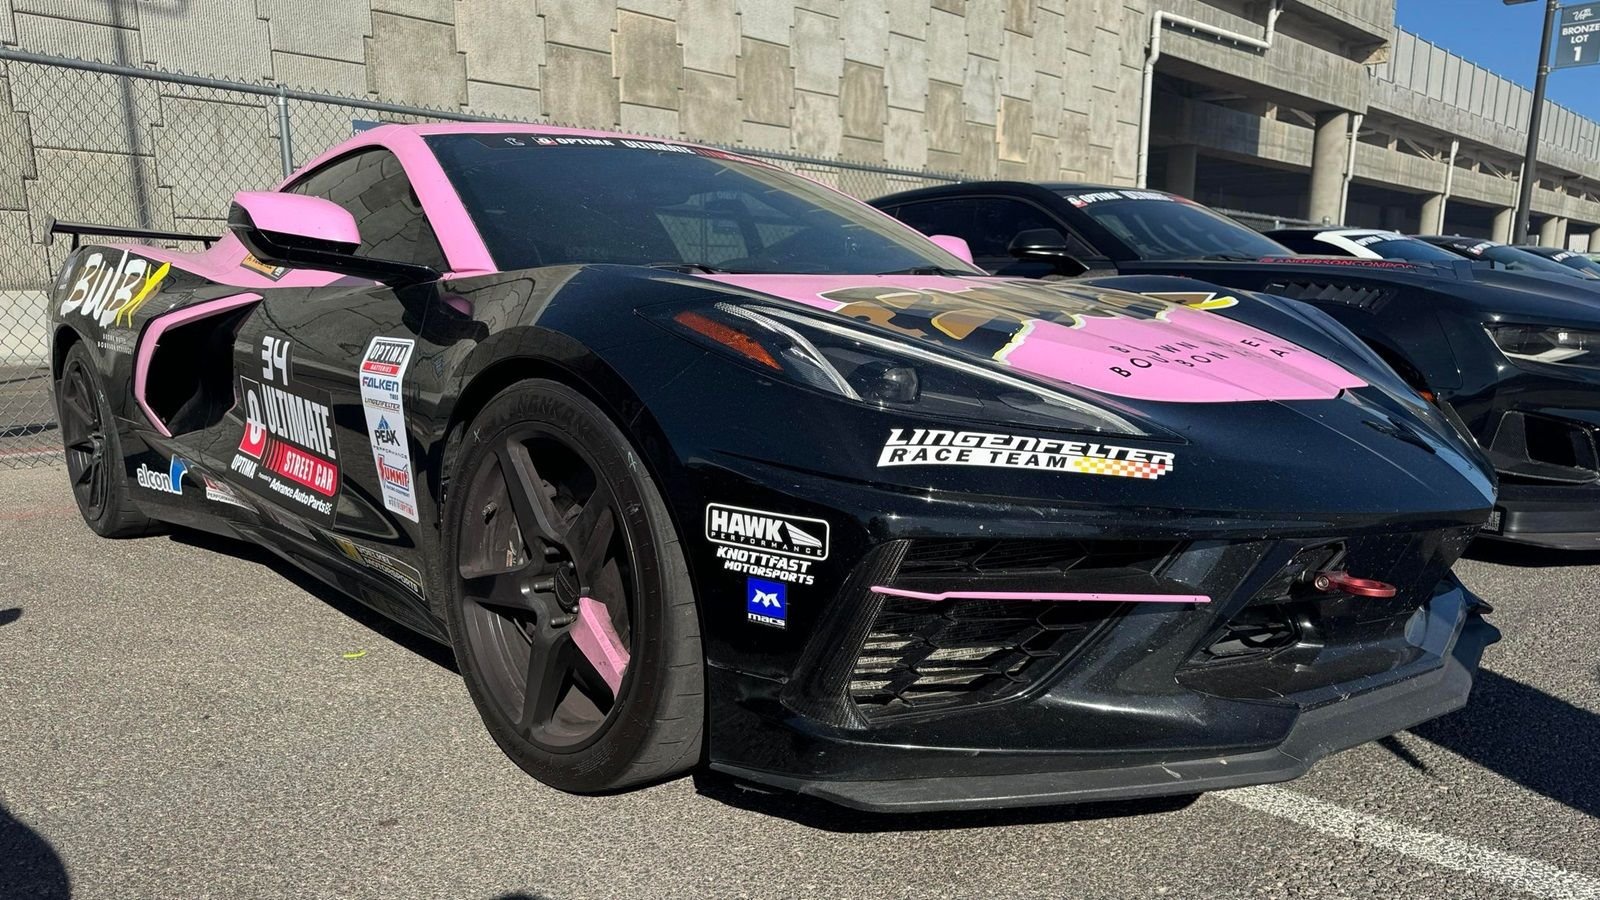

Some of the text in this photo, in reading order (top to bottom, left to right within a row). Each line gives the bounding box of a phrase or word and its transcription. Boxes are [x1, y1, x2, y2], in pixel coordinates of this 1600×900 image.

[1562, 23, 1600, 36] BRONZE
[1570, 34, 1589, 44] LOT
[1573, 46, 1582, 61] 1
[556, 136, 697, 155] OPTIMA ULTIMATE
[262, 336, 290, 386] 34
[370, 344, 407, 364] OPTIMA
[362, 376, 399, 393] FALKEN
[261, 383, 336, 460] ULTIMATE
[374, 429, 400, 446] PEAK
[885, 428, 1176, 464] LINGENFELTER
[230, 454, 258, 479] OPTIMA
[888, 447, 1067, 468] RACE TEAM
[137, 463, 172, 493] alcon
[284, 451, 314, 482] STREET
[315, 464, 334, 491] CAR
[269, 478, 327, 513] Advance Auto Parts
[711, 509, 783, 542] HAWK
[711, 531, 823, 556] PERFORMANCE
[716, 546, 812, 573] KNOTTFAST
[724, 560, 815, 585] MOTORSPORTS
[748, 612, 786, 627] macs
